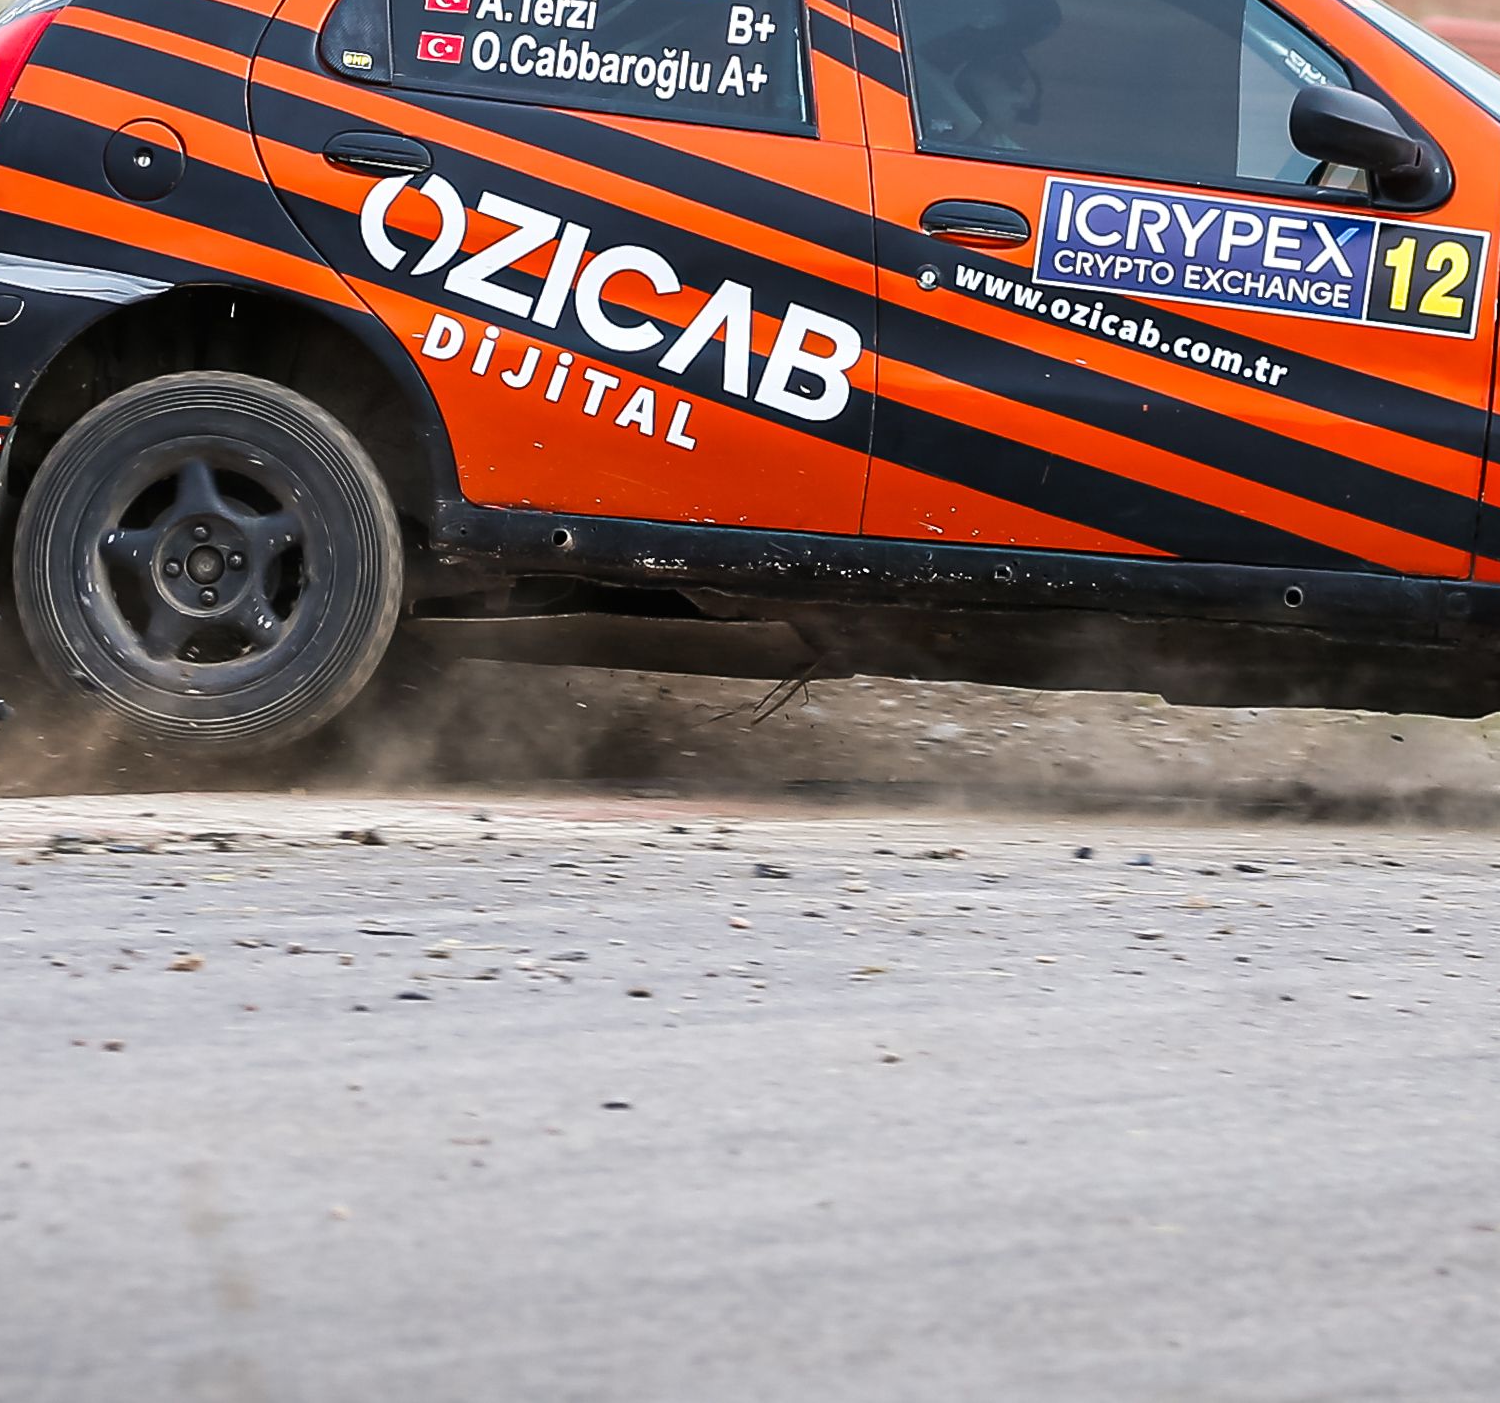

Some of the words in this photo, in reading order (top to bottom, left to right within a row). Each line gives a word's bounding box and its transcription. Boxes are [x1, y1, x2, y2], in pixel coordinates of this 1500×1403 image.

[727, 5, 776, 44] B+
[471, 31, 711, 99] O.Cabbaroğlu
[717, 55, 768, 96] A+
[1054, 189, 1360, 278] ICRYPEX
[1052, 253, 1175, 285] CRYPTO
[1183, 267, 1351, 309] EXCHANGE
[1384, 238, 1471, 318] 12
[954, 265, 1288, 388] www.ozicab.com.tr
